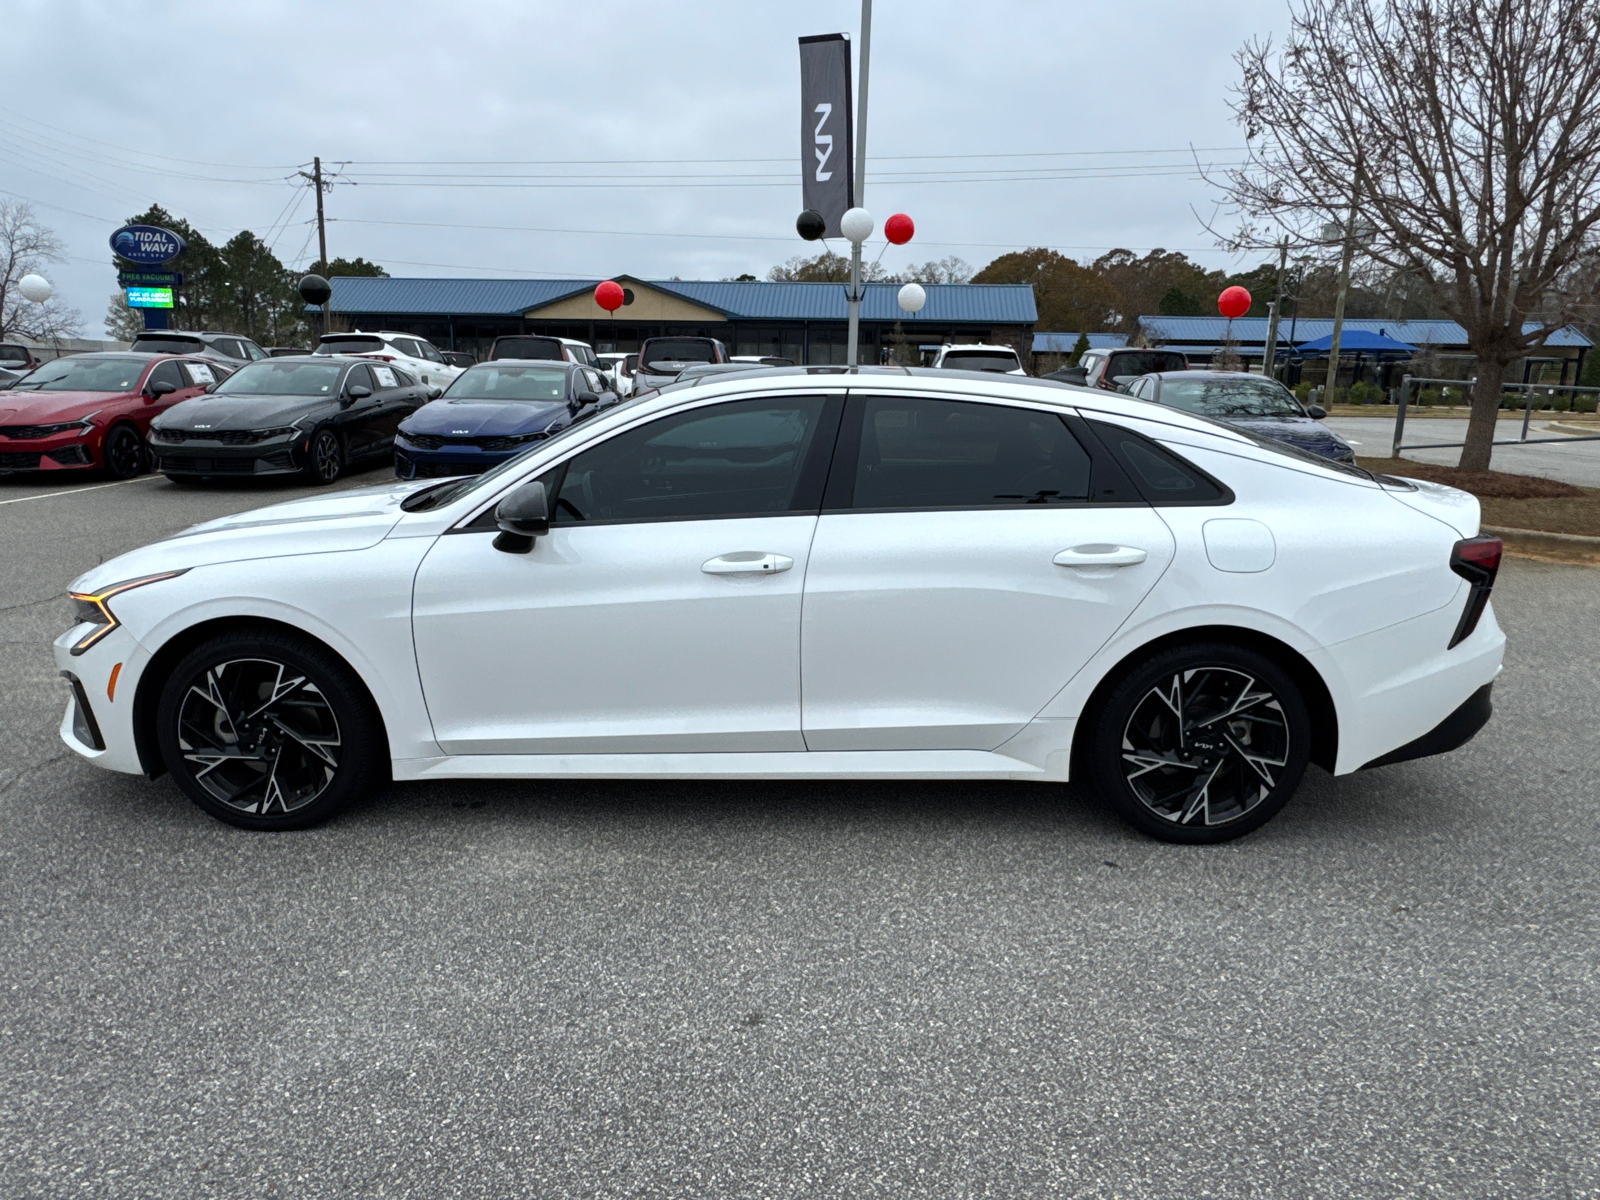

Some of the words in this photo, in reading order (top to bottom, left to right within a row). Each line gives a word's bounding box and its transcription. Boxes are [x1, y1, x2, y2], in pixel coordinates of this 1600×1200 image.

[134, 231, 168, 243] TIDAL
[140, 242, 175, 253] WAVE
[141, 273, 175, 281] VACUUMS
